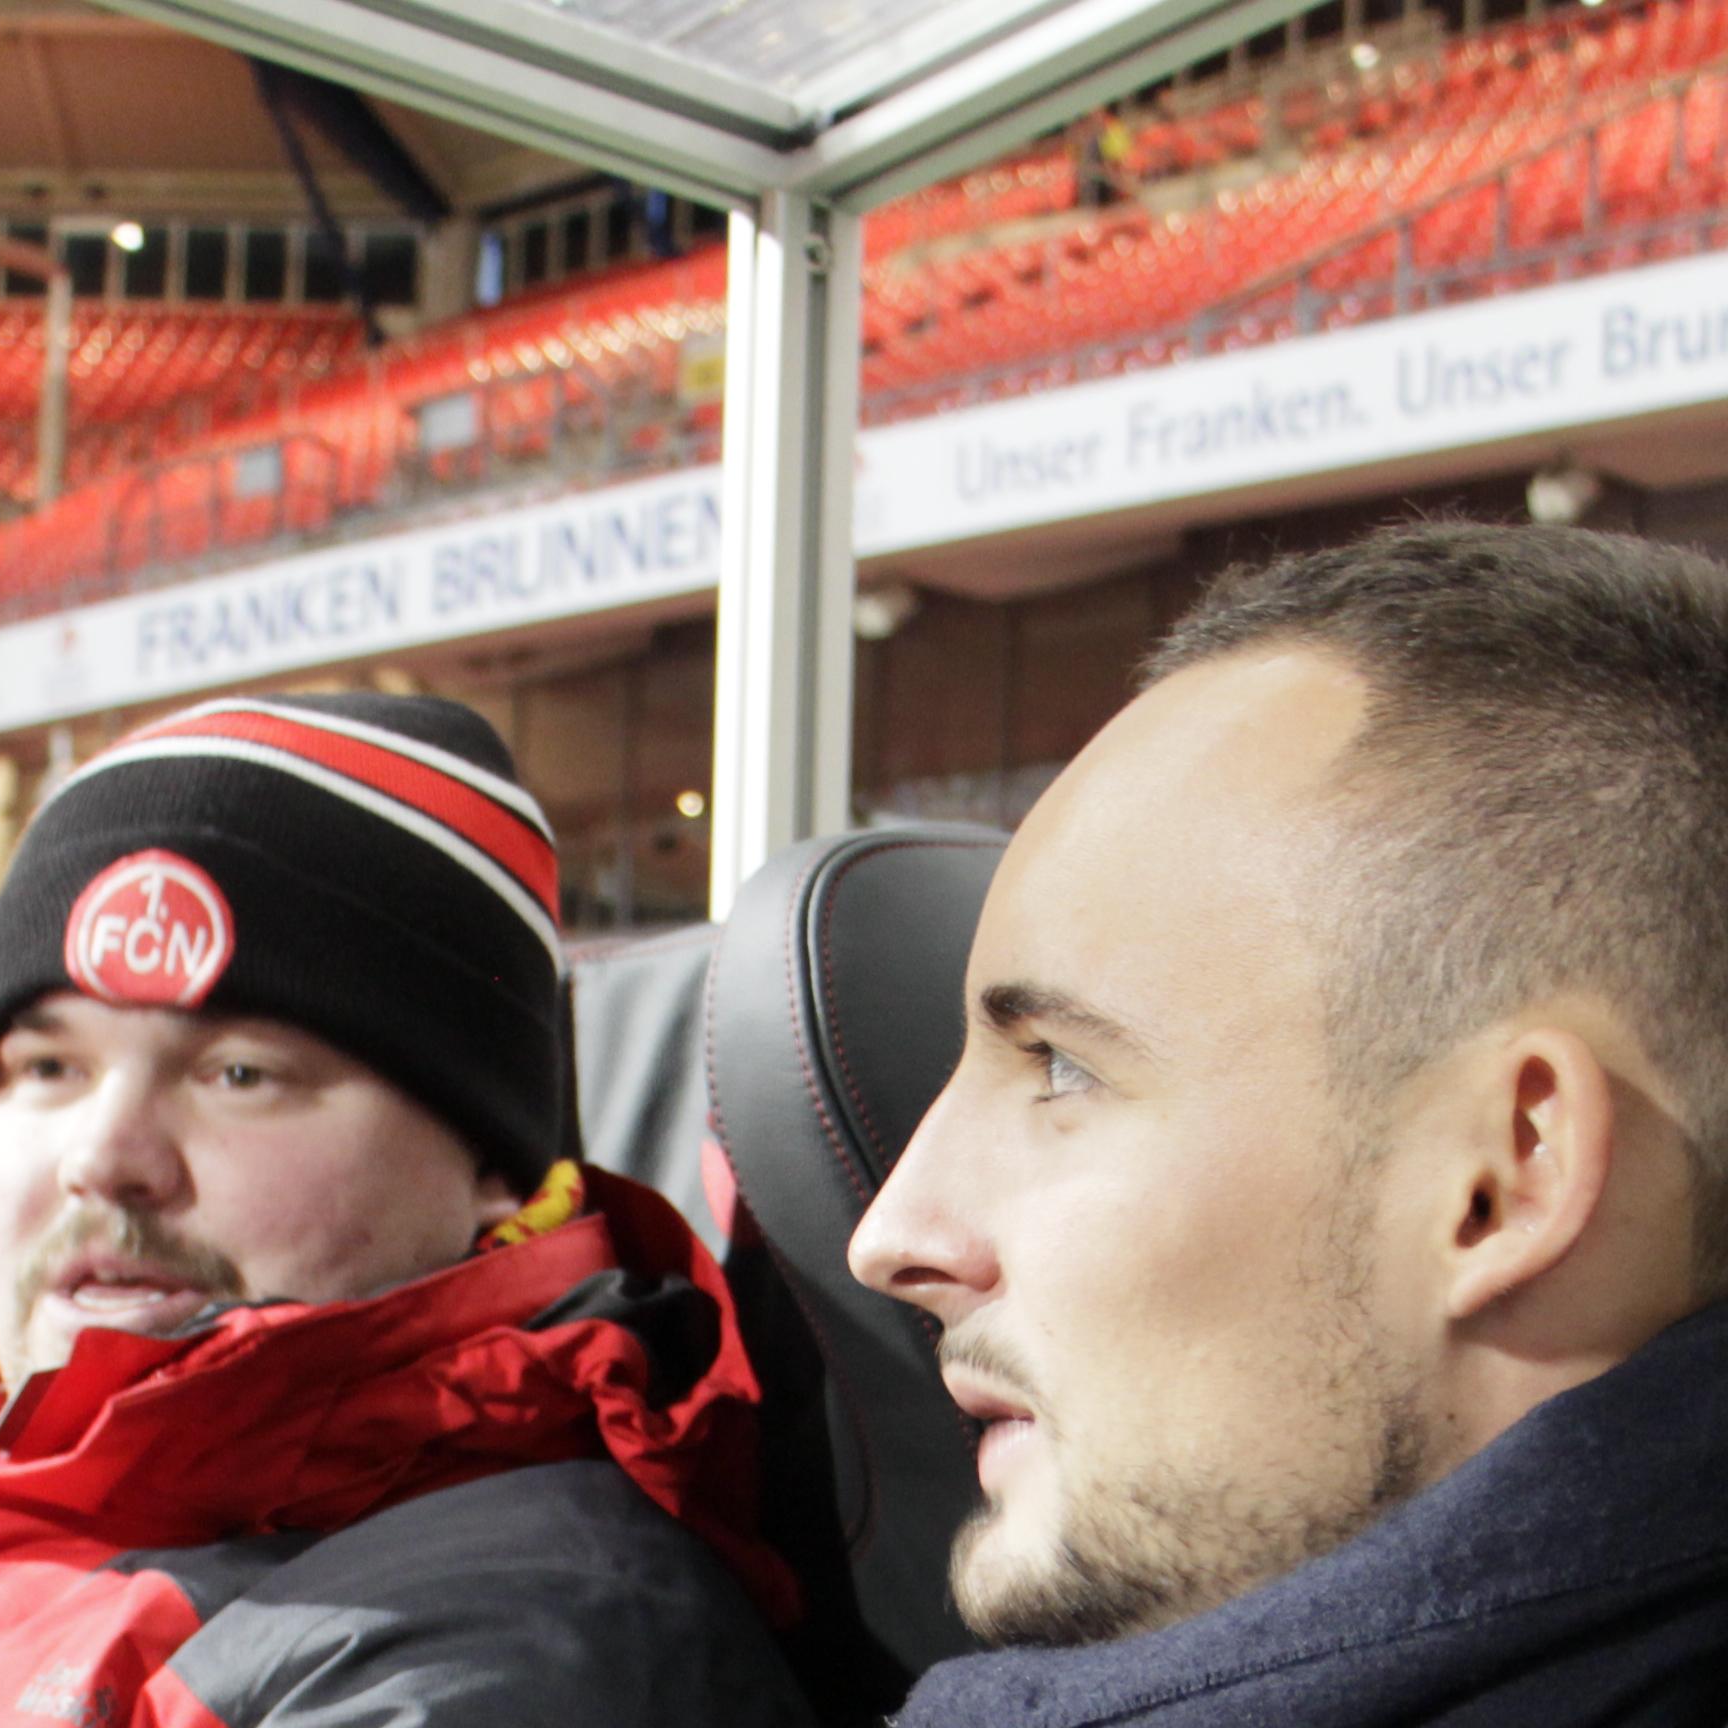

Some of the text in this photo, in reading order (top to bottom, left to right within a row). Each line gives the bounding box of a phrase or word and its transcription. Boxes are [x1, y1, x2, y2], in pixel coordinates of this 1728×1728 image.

[954, 431, 1103, 505] Unser
[1124, 379, 1368, 469] Franken.
[1395, 336, 1572, 415] Unser
[135, 560, 402, 678] FRANKEN
[90, 913, 207, 977] FCN
